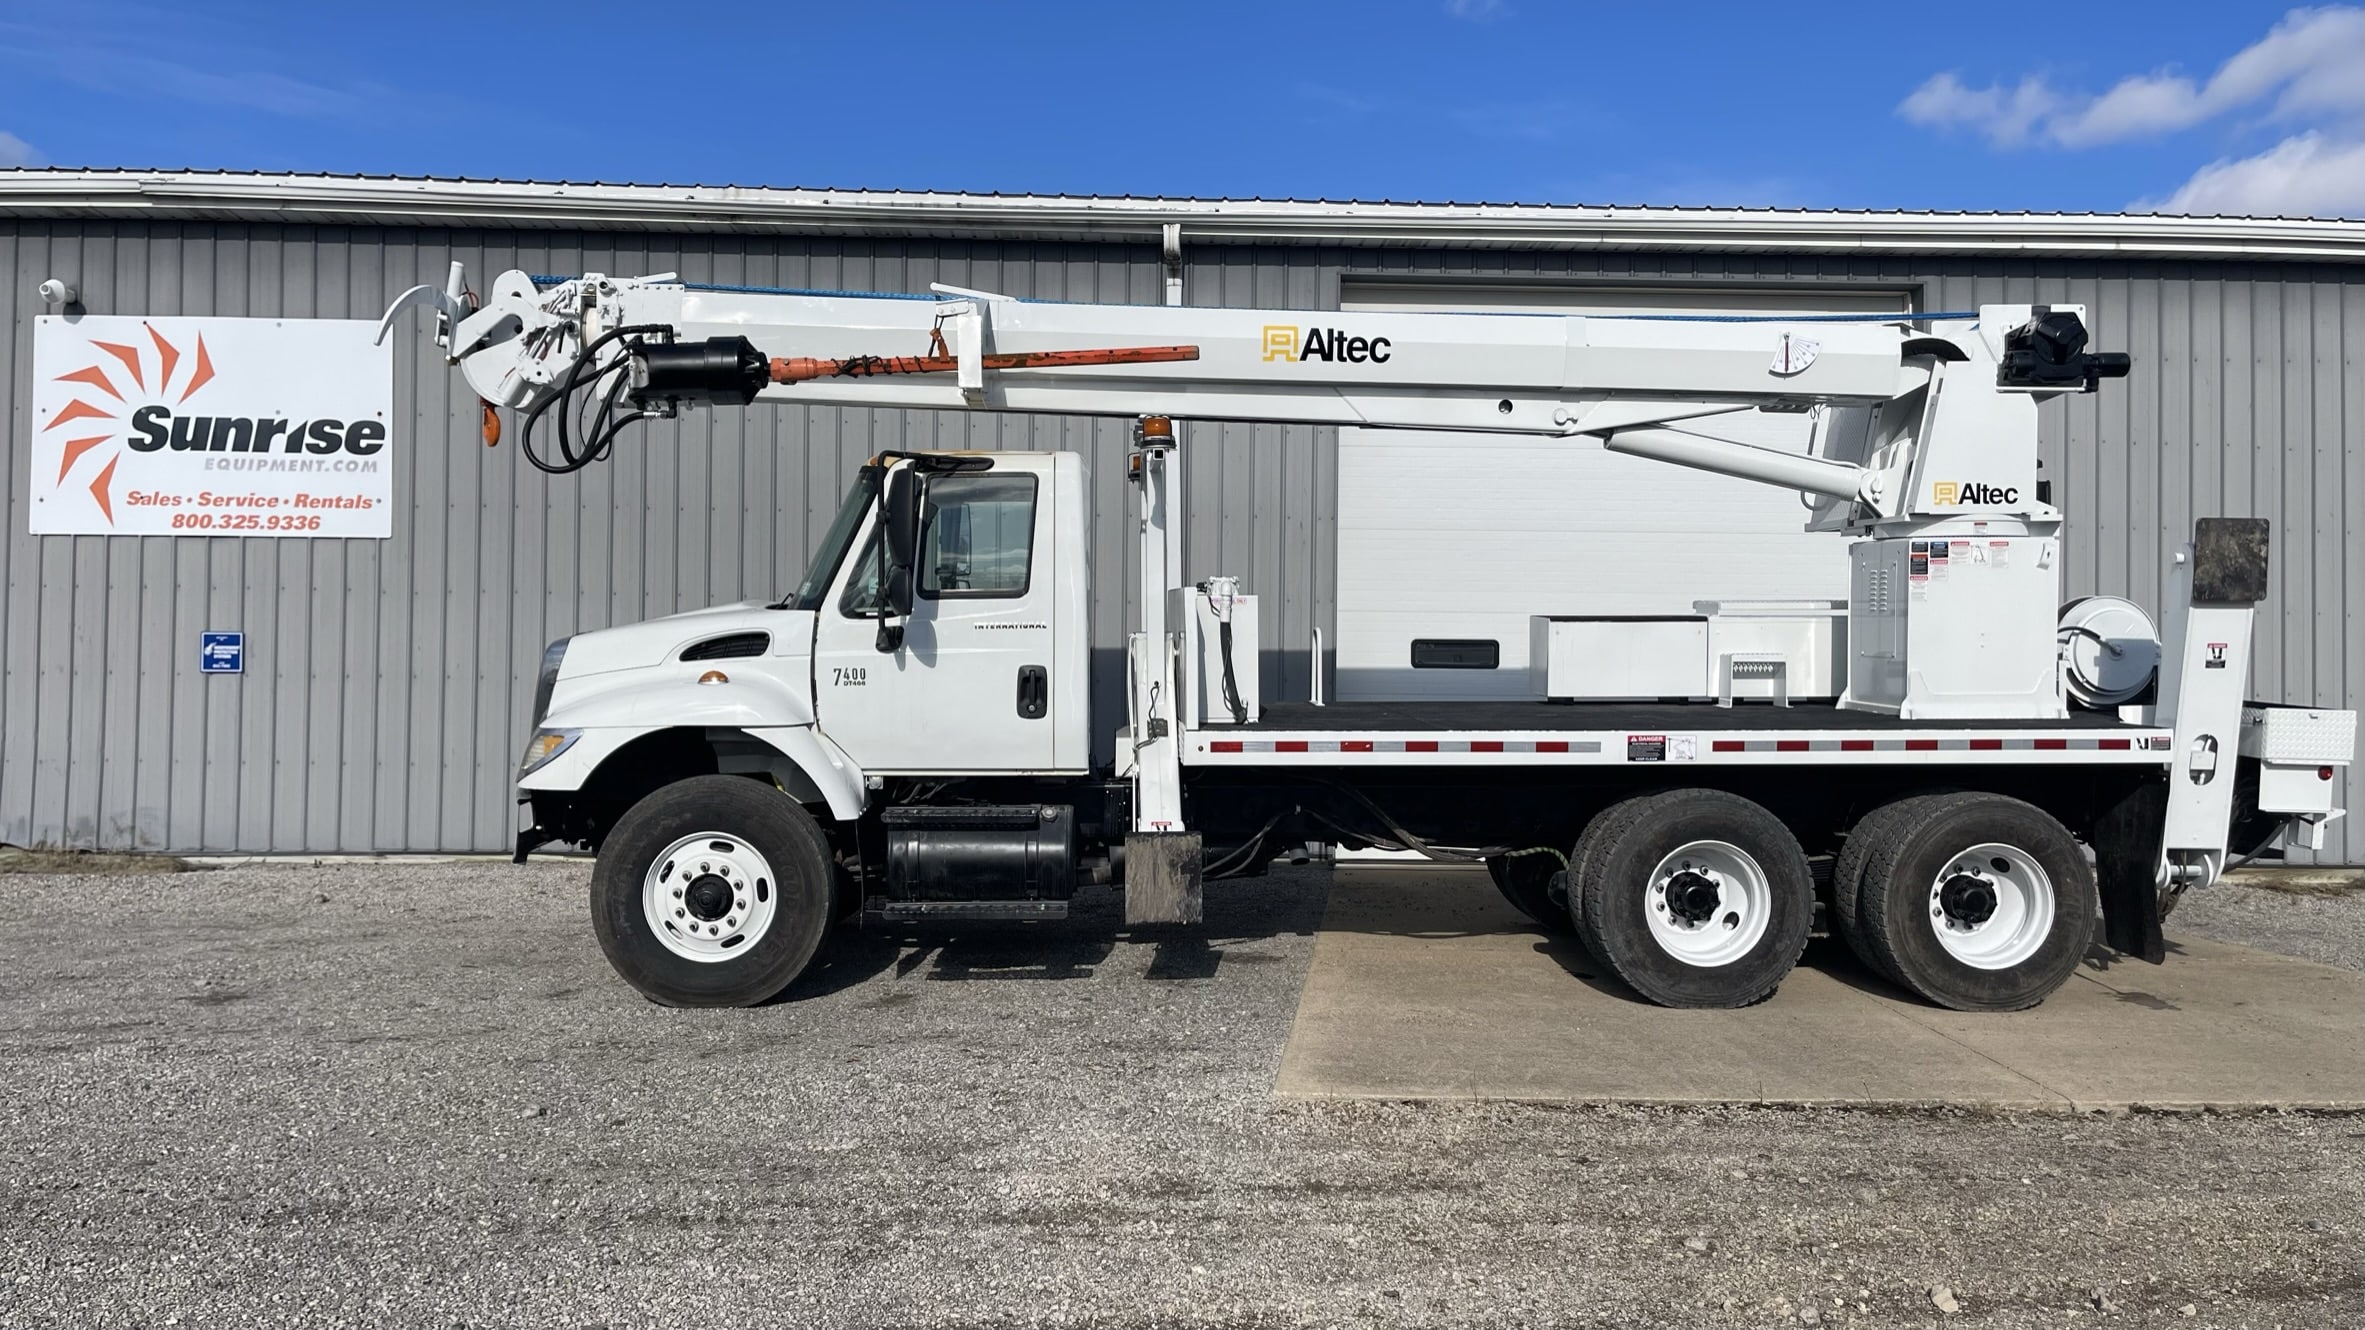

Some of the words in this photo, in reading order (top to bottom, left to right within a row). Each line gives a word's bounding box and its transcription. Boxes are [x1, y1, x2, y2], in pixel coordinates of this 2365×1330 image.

[1299, 328, 1391, 363] Altec
[127, 405, 386, 456] Sunrise
[204, 457, 378, 473] EQUIPMENT.COM
[126, 490, 182, 507] Sales
[197, 491, 279, 508] Service
[294, 493, 373, 509] Rentals
[1958, 483, 2018, 504] Altec
[171, 513, 321, 530] 800.325.9336
[833, 667, 866, 687] 7400
